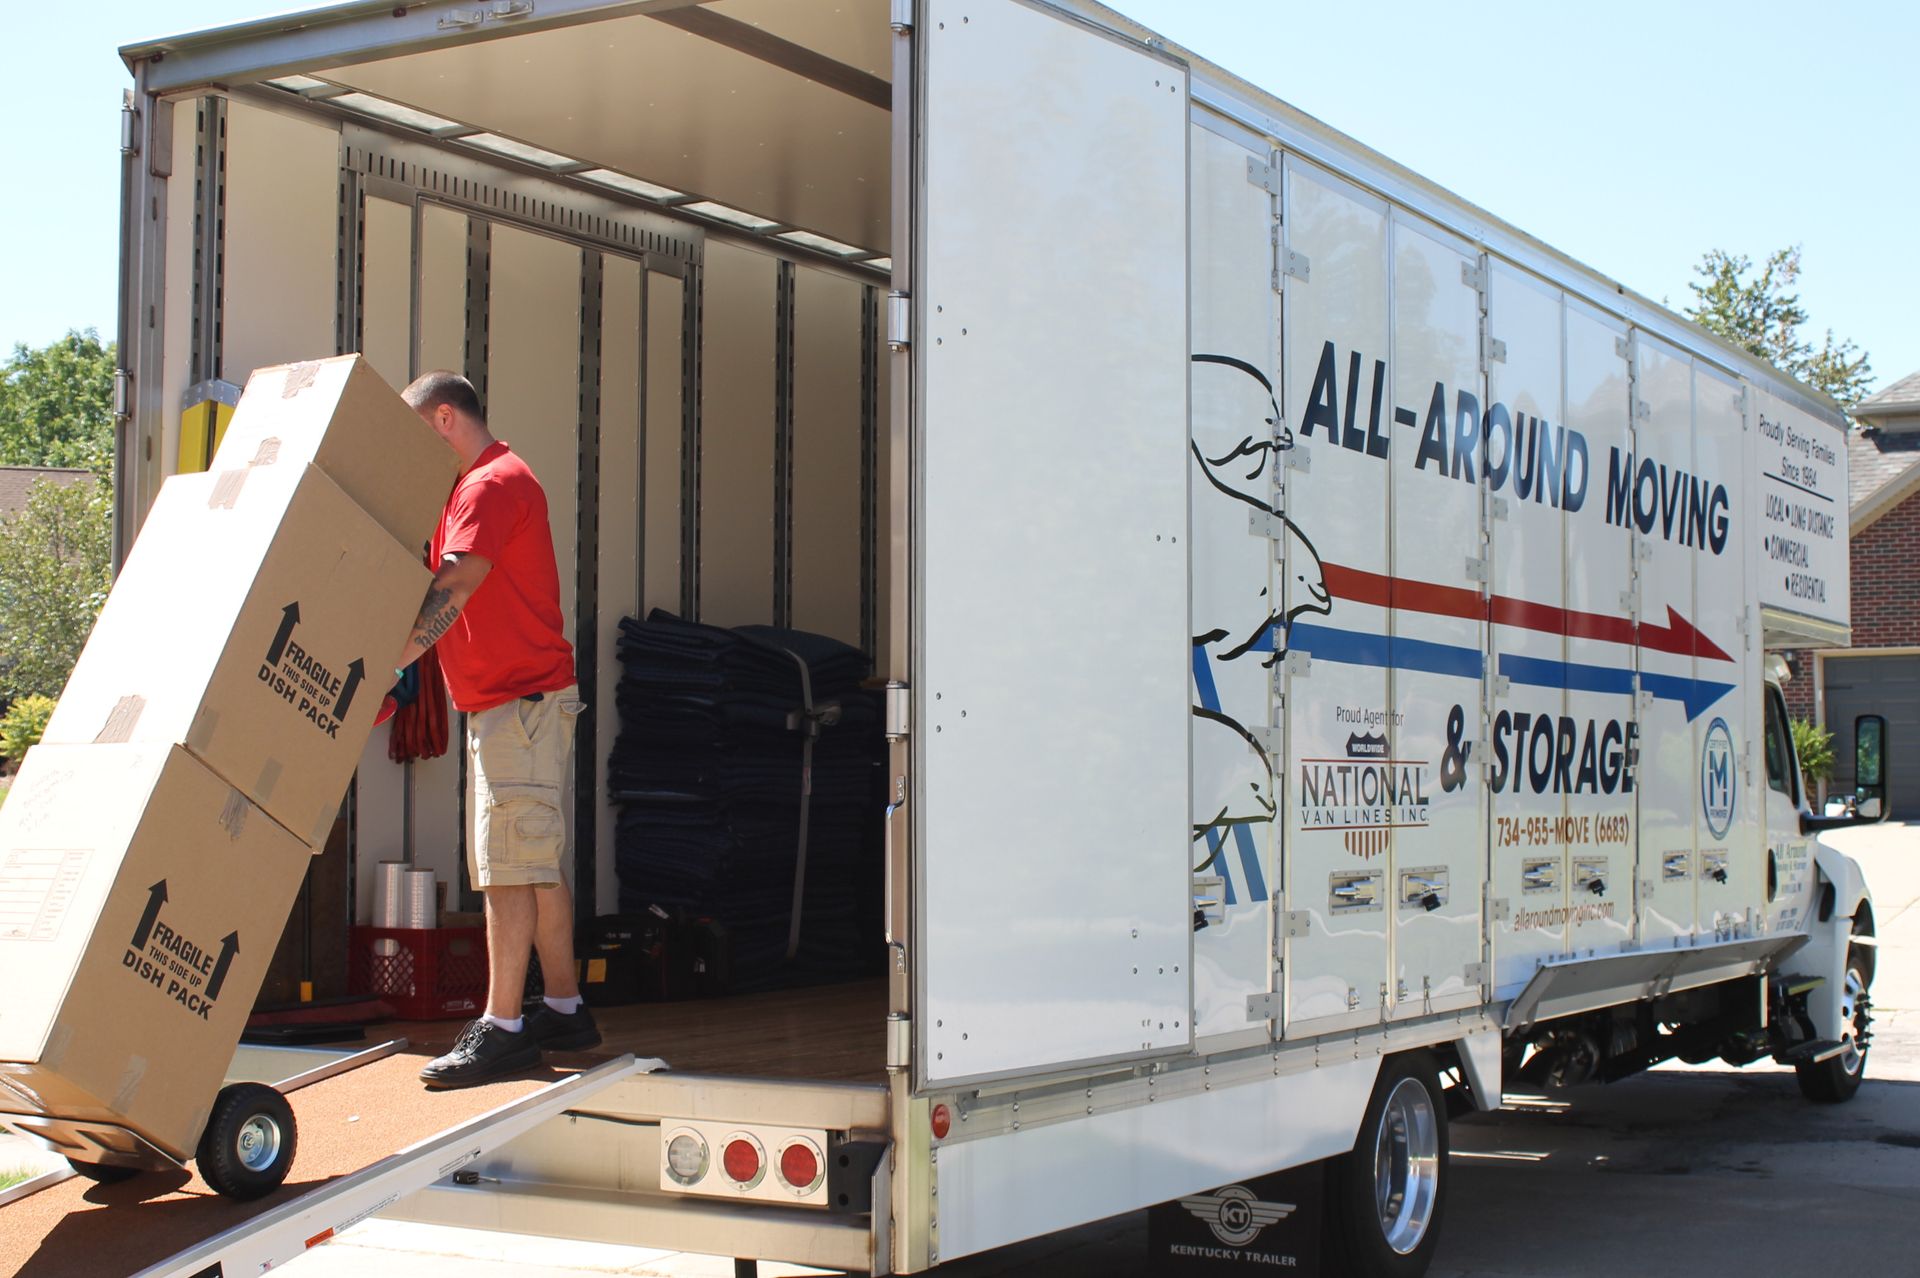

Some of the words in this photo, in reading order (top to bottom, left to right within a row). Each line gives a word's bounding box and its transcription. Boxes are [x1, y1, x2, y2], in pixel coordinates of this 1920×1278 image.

[1300, 340, 1588, 512] ALL-AROUND
[1605, 446, 1729, 555] MOVING
[1759, 414, 1784, 446] Proudly
[1786, 426, 1810, 459] Serving
[1812, 438, 1835, 466] Families
[1781, 456, 1799, 482] Since
[1802, 465, 1817, 488] 1984
[1766, 493, 1784, 522] LOCAL
[1790, 503, 1806, 530] LONG
[1808, 509, 1834, 539] DISTANCE
[1770, 534, 1809, 568] COMMERCIAL
[1790, 573, 1826, 603] RESIDENTIAL
[282, 663, 300, 684] THIS
[300, 678, 319, 699] SIDE
[318, 694, 331, 707] UP
[285, 640, 341, 697] FRAGILE
[258, 663, 297, 704] DISH
[298, 697, 340, 740] PACK
[1337, 706, 1361, 724] Proud
[1364, 707, 1388, 728] Agent
[1391, 710, 1404, 726] for
[1352, 743, 1385, 753] WORLDWIDE
[1440, 704, 1472, 793] &
[1491, 709, 1639, 795] STORAGE
[1302, 765, 1429, 807] NATIONAL
[1302, 810, 1335, 824] VAN
[1401, 808, 1429, 822] INC.
[1497, 816, 1589, 847] 734-955-MOVE
[1595, 813, 1629, 846] (6683)
[1514, 901, 1615, 932] allaroundmovinginc.com
[149, 945, 169, 966] THIS
[168, 960, 189, 980] SIDE
[189, 974, 202, 987] UP
[152, 921, 214, 976] FRAGILE
[123, 949, 165, 988] DISH
[167, 979, 213, 1021] PACK
[1223, 1207, 1248, 1223] KT
[1170, 1244, 1241, 1260] KENTUCKY
[1245, 1251, 1297, 1267] TRAILER
